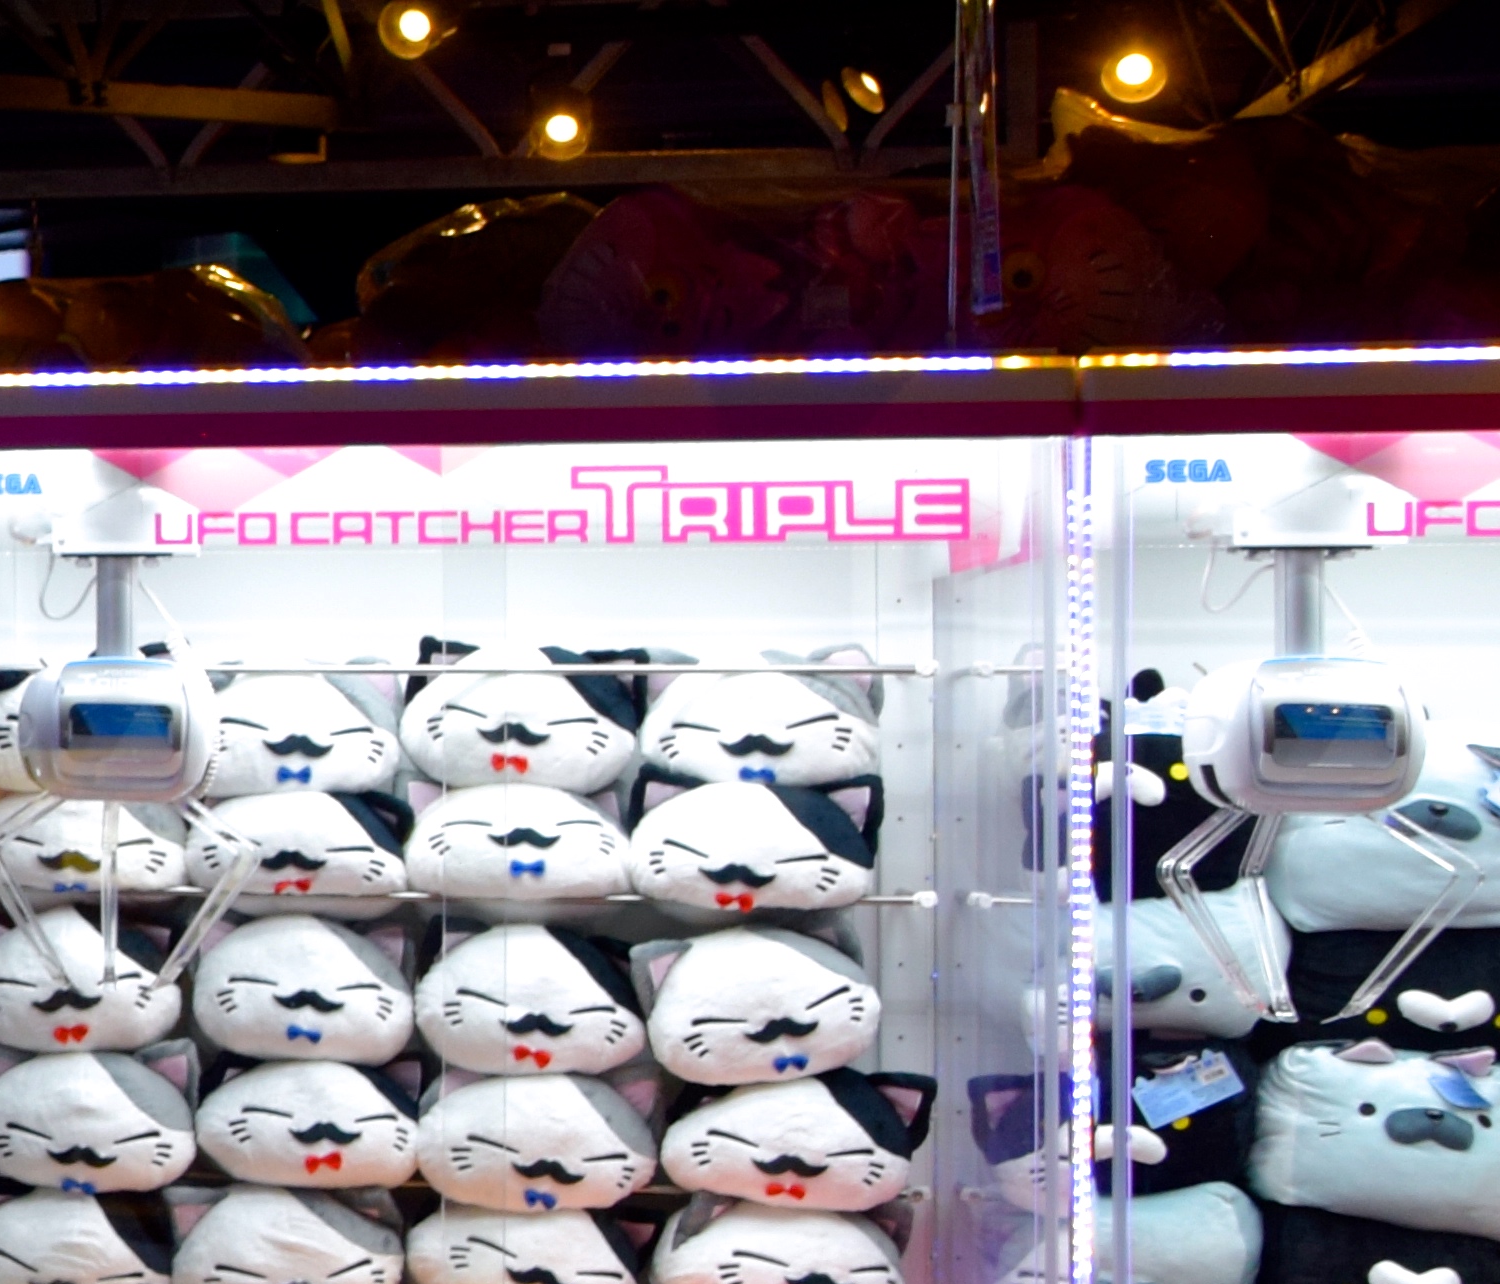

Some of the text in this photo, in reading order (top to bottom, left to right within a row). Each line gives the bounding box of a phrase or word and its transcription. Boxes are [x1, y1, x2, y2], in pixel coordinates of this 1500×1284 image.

[1145, 459, 1232, 483] SEGA
[154, 511, 280, 545] UFO
[290, 510, 590, 545] CATCHER
